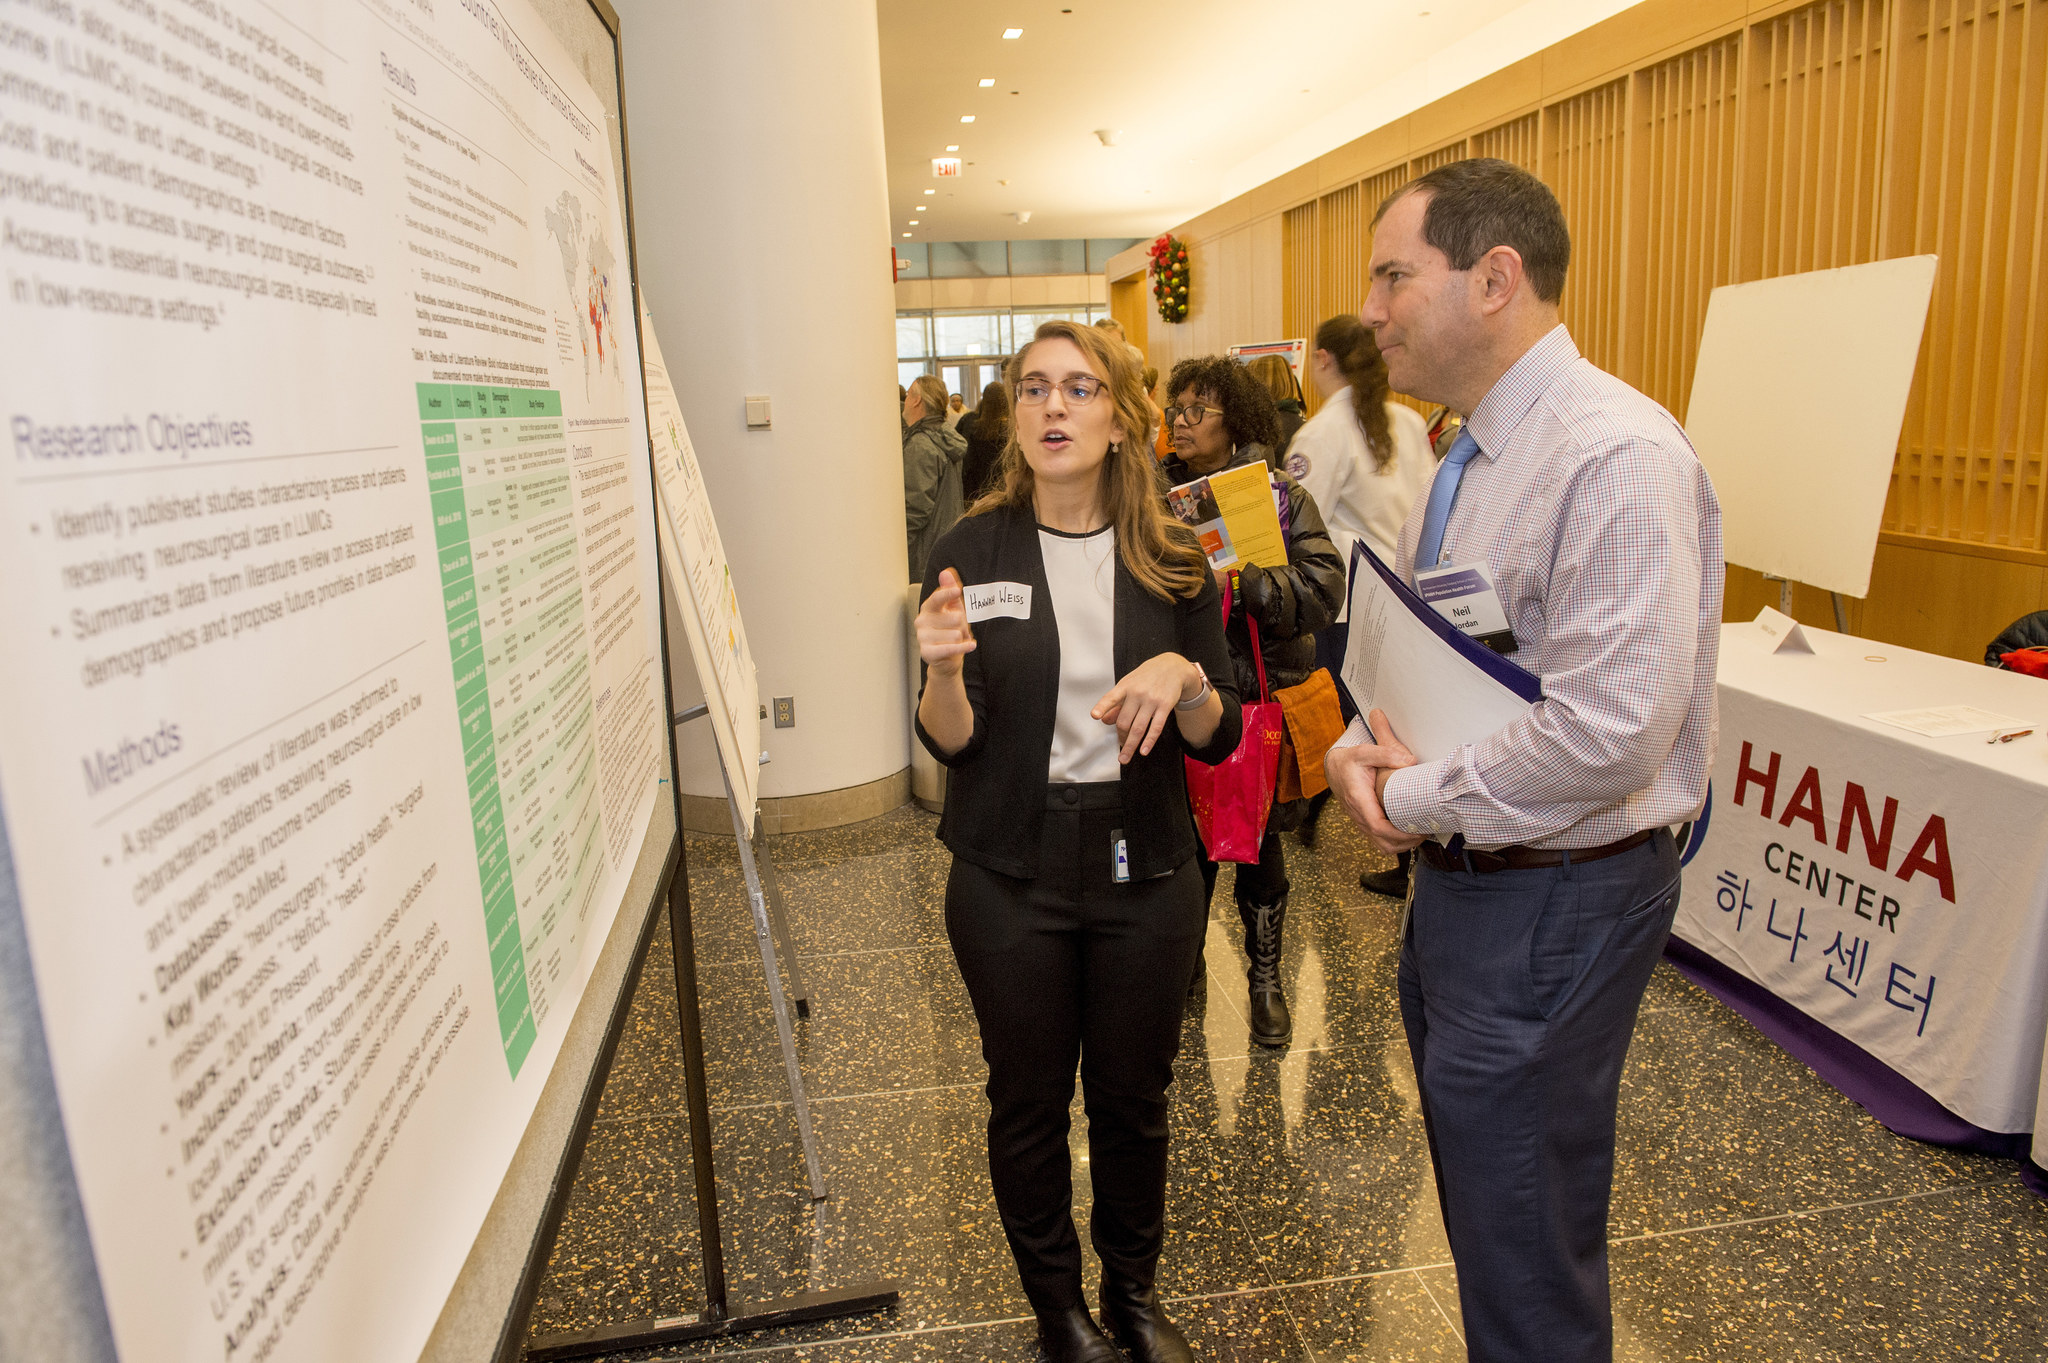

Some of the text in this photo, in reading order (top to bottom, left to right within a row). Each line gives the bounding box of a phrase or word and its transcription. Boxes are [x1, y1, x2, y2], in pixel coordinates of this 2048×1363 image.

[380, 50, 416, 97] Results
[11, 412, 253, 462] Research Objectives
[51, 465, 407, 541] Identify published studies characterizing access and patients
[62, 549, 146, 590] receiving
[153, 524, 250, 567] neurosurgical
[253, 524, 280, 546] care
[281, 516, 294, 540] in
[69, 521, 415, 641] Summarize data from literature review on access and patient
[81, 551, 416, 687] demographics and propose future priorities in data collection
[1452, 605, 1471, 617] Neil
[82, 717, 183, 799] Methods
[121, 677, 399, 863] A systematic review of literature was performed to
[132, 827, 219, 908] characterize
[220, 792, 273, 847] patients
[275, 756, 326, 803] receiving
[326, 714, 384, 771] neurosurgical
[384, 706, 401, 731] care
[1733, 740, 1956, 905] HANA
[146, 778, 352, 953] and lower-middle income countries
[232, 858, 288, 921] PubMed
[1764, 842, 1901, 934] CENTER
[257, 1004, 271, 1029] to
[270, 950, 322, 1012] Present
[1716, 869, 1937, 1037] 하나센터
[181, 1076, 249, 1165] Inclusion
[196, 1144, 268, 1245] Exclusion
[324, 1033, 362, 1086] Studies
[222, 1083, 281, 1161] hospitals
[202, 1206, 256, 1286] military
[256, 1137, 312, 1214] missions
[269, 1174, 317, 1246] surgery
[291, 1212, 323, 1261] Data
